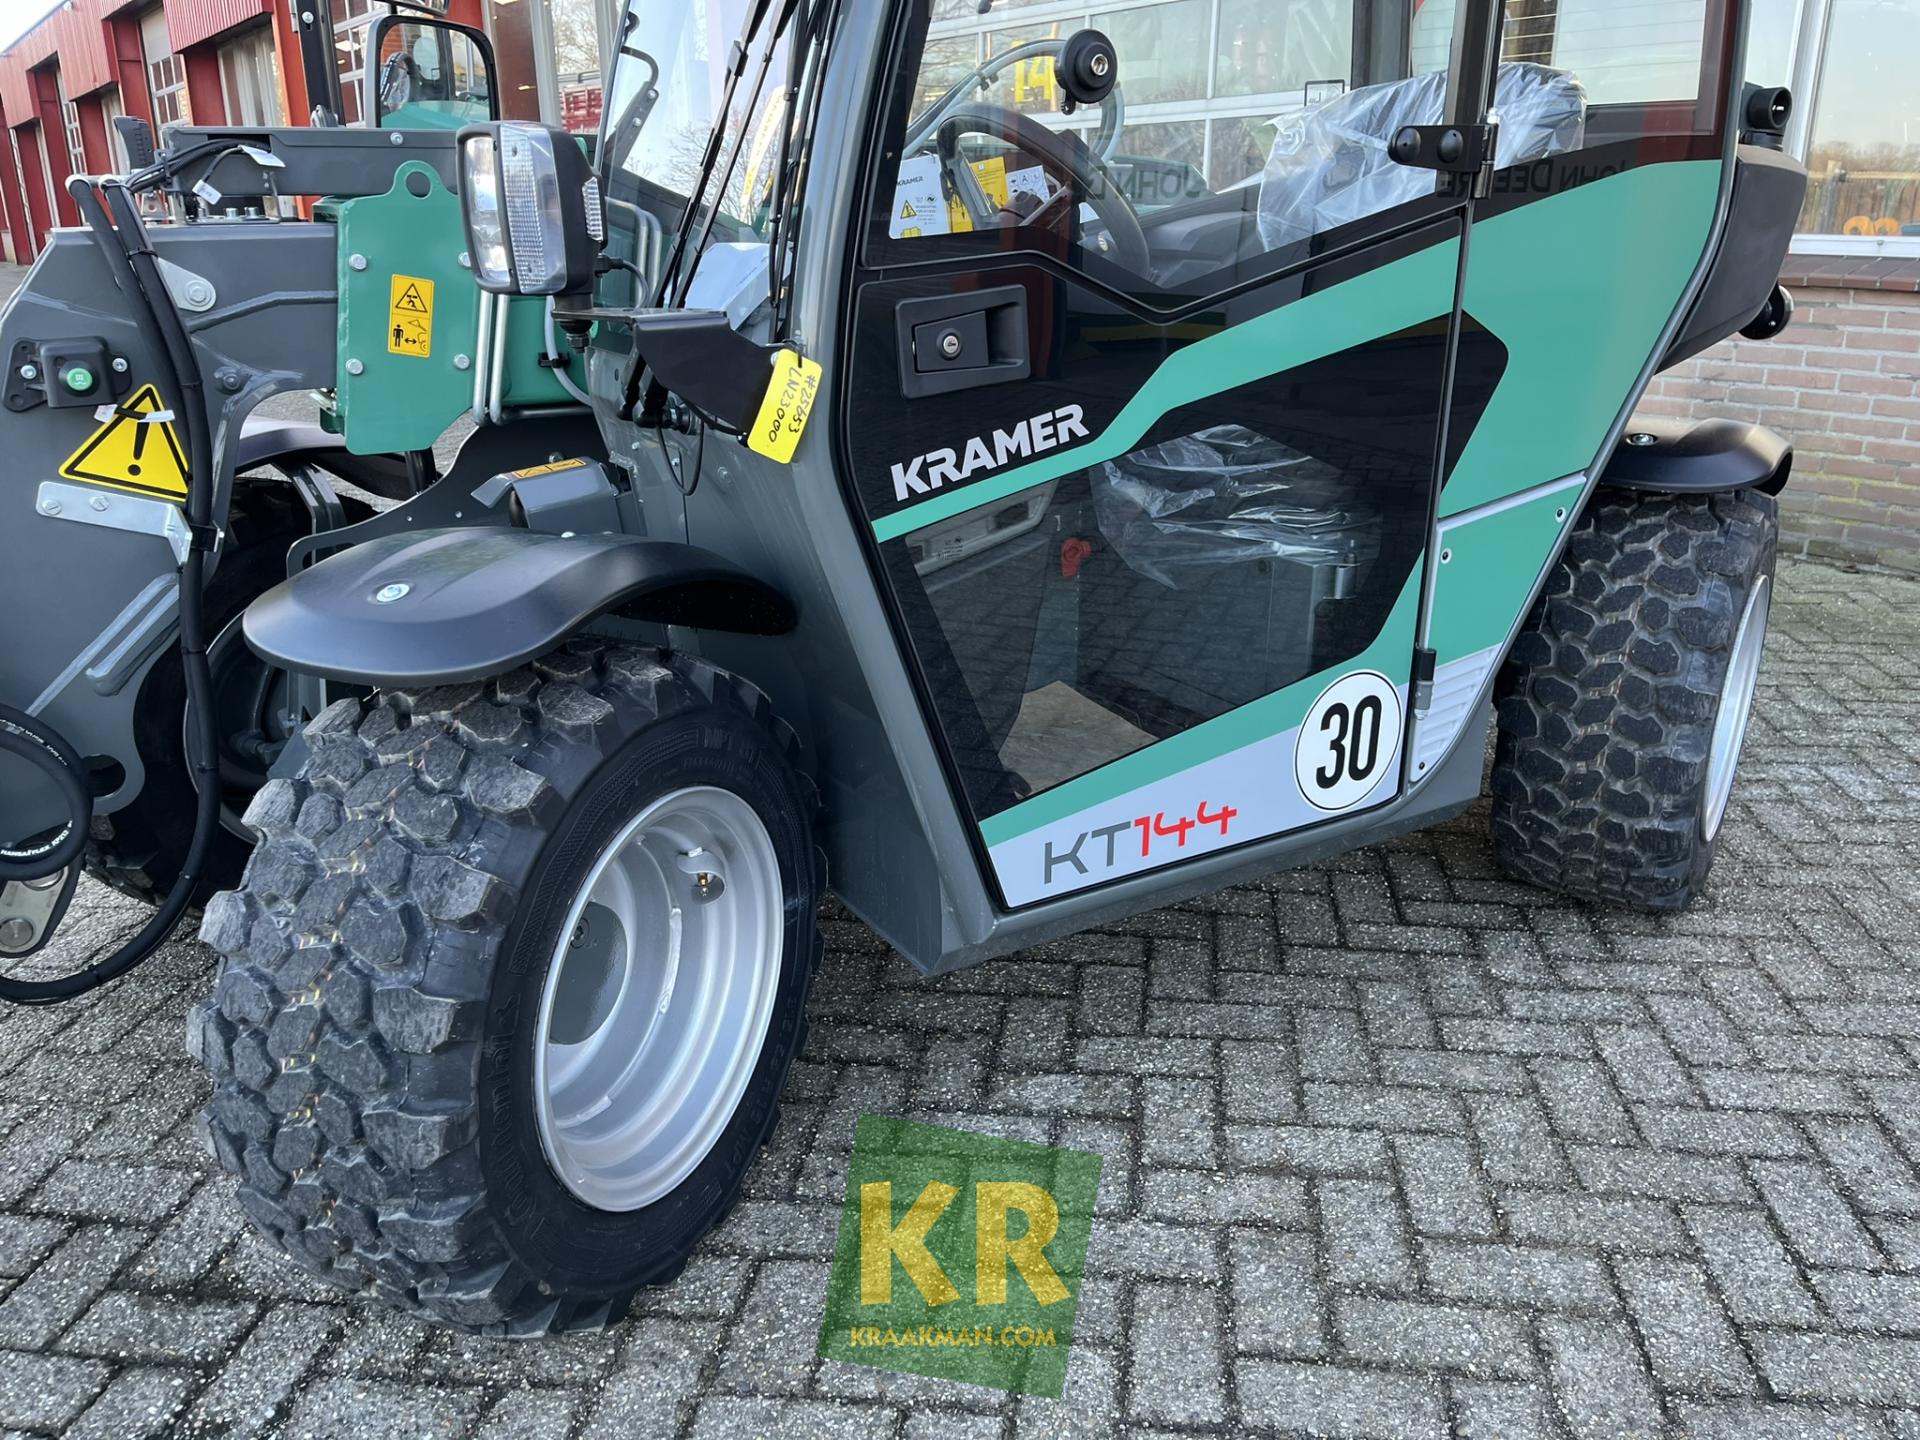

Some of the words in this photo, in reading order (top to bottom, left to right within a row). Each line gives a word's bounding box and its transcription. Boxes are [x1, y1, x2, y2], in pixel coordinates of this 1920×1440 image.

[768, 366, 802, 443] LN23000
[890, 403, 1090, 502] KRAMER
[1316, 694, 1383, 790] 30
[1043, 800, 1238, 885] KT144
